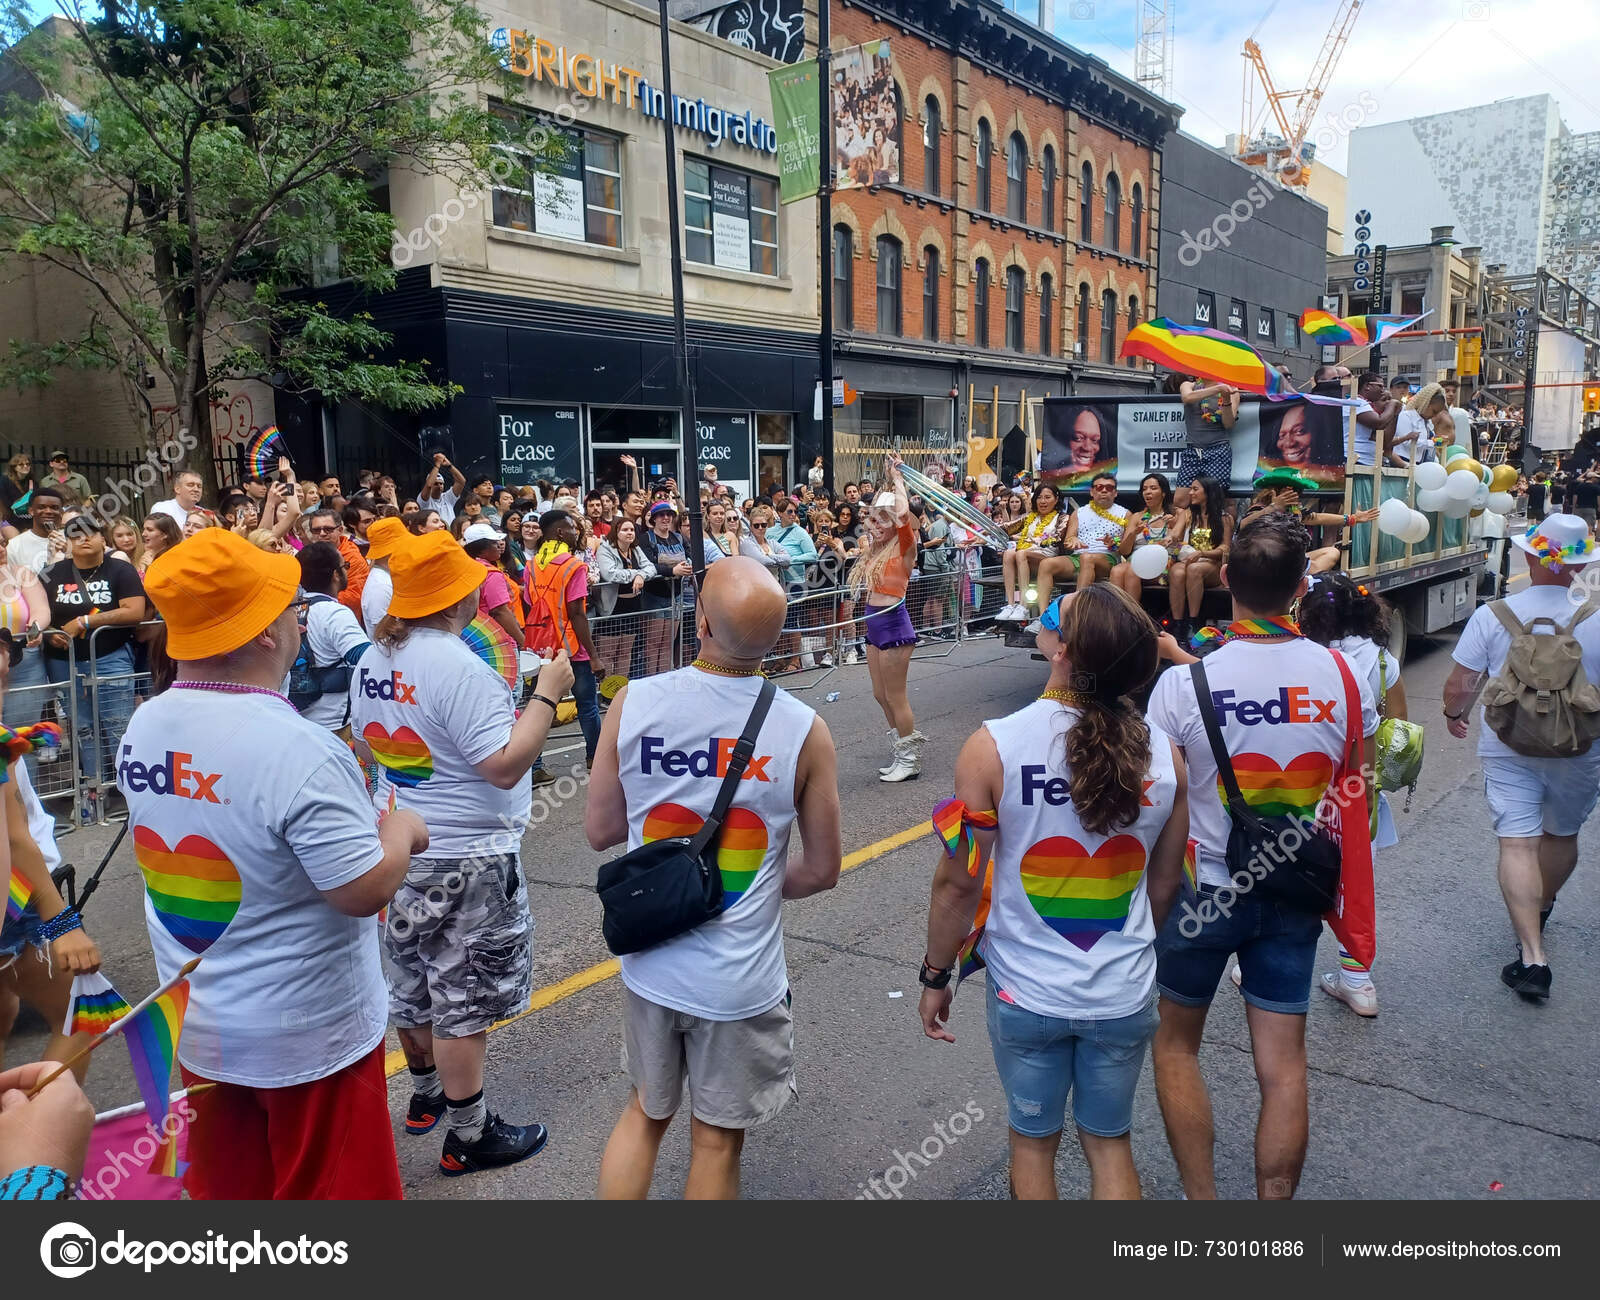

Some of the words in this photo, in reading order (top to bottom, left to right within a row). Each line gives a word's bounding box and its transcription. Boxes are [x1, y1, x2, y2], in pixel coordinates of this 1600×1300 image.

[509, 28, 642, 111] BRIGHT
[638, 79, 777, 153] immigratio
[1374, 250, 1383, 308] DOWNTOWN
[499, 415, 533, 437] For
[555, 411, 575, 419] CBRE
[1133, 411, 1169, 422] STANLEY
[1152, 431, 1188, 442] HAPPY
[500, 439, 555, 461] Lease
[697, 445, 731, 460] ease
[1149, 451, 1169, 470] BE
[501, 463, 524, 474] Retail
[358, 668, 417, 706] FedEx
[1211, 686, 1338, 727] FedEx
[641, 736, 773, 783] FedEx
[119, 744, 223, 804] FedEx
